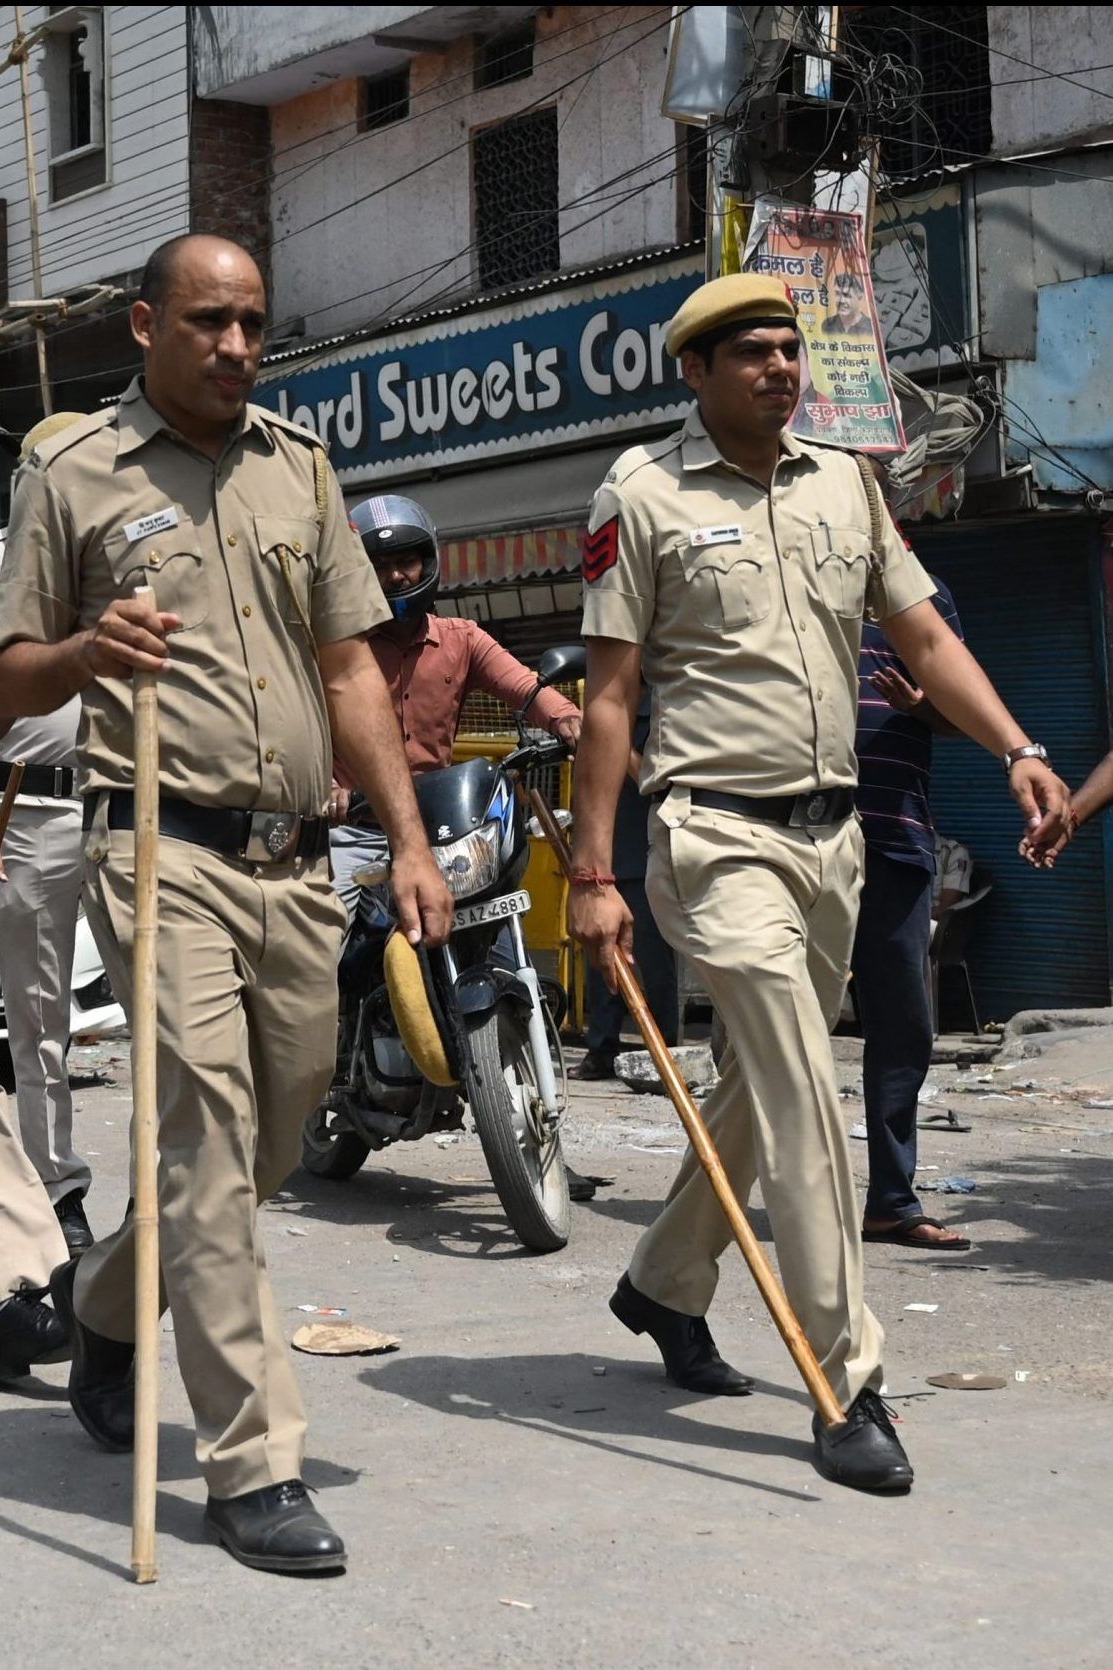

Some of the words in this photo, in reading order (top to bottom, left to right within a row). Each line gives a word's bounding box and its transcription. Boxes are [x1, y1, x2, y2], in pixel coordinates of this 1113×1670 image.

[809, 252, 824, 278] है
[817, 284, 829, 307] है
[841, 341, 875, 352] विकास
[377, 341, 562, 442] Sweets
[807, 403, 859, 424] सुभाष
[862, 402, 891, 420] झा
